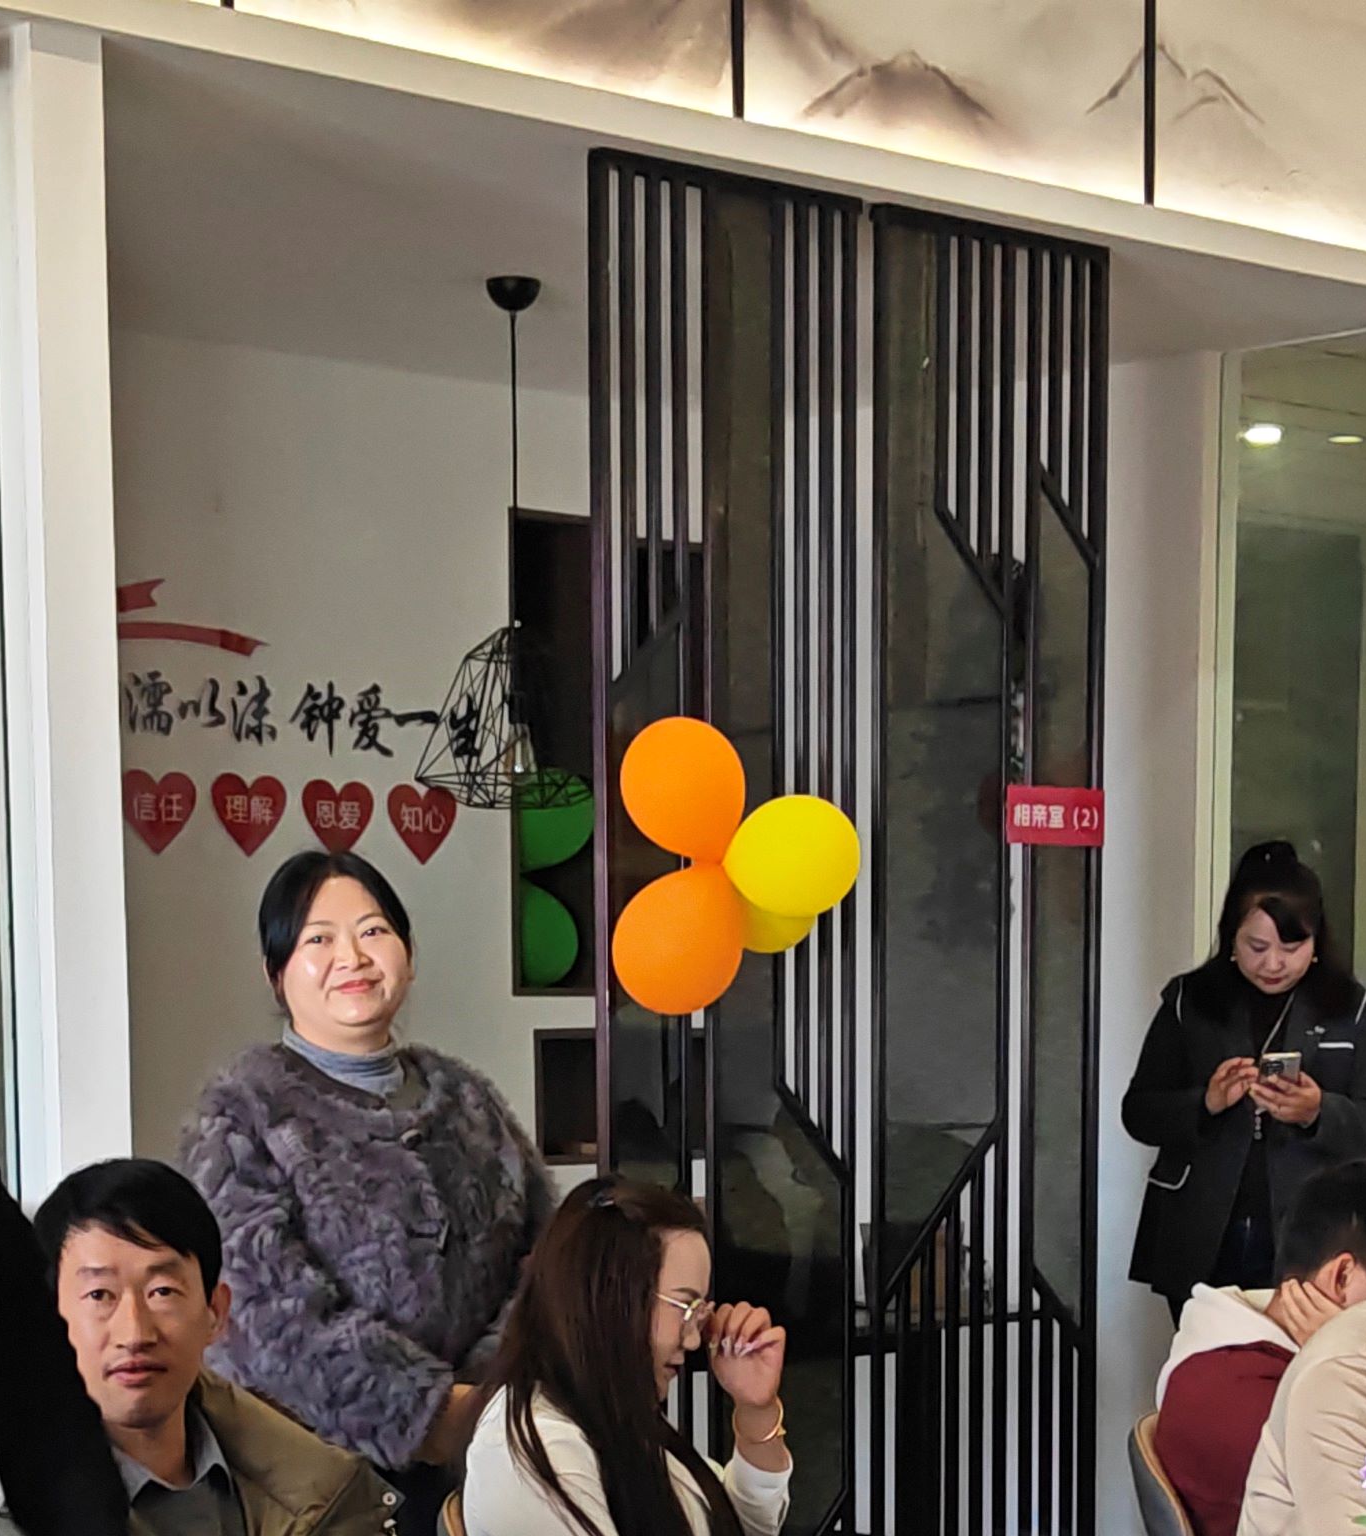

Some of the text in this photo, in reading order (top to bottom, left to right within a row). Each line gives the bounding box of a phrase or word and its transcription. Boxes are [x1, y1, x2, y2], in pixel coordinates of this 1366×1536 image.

[134, 792, 184, 822] 信任
[225, 794, 274, 825] 理解
[315, 800, 361, 830] 恩爱
[400, 803, 446, 833] 知心
